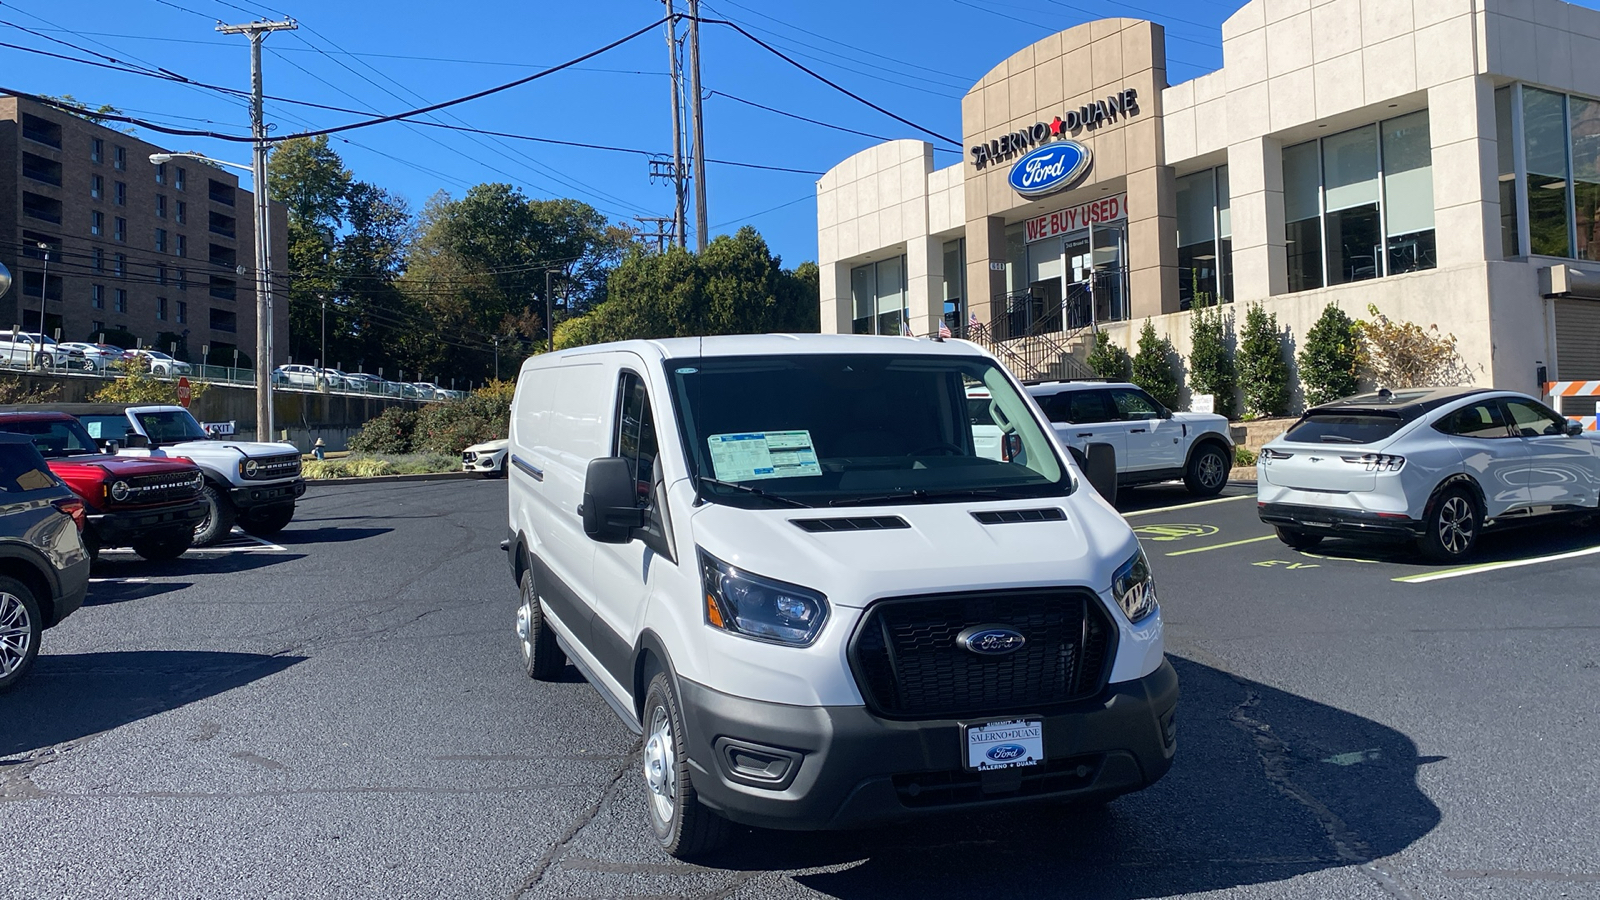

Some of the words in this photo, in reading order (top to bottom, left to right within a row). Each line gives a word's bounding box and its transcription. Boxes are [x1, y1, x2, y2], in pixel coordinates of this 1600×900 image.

[970, 122, 1049, 165] SALERNO
[1065, 88, 1137, 131] DUANE
[1022, 152, 1065, 187] Ford
[1026, 216, 1047, 240] WE
[1051, 209, 1077, 235] BUY
[1081, 197, 1119, 227] USED
[179, 386, 190, 399] STOP
[266, 461, 298, 469] BRONCO
[142, 480, 191, 491] BRONCO
[981, 633, 1013, 650] Ford
[970, 731, 1008, 743] SALERNO
[1012, 728, 1040, 739] DUANE
[993, 746, 1018, 759] Ford
[977, 763, 1008, 772] SALERNO
[1016, 760, 1038, 768] DUANE
